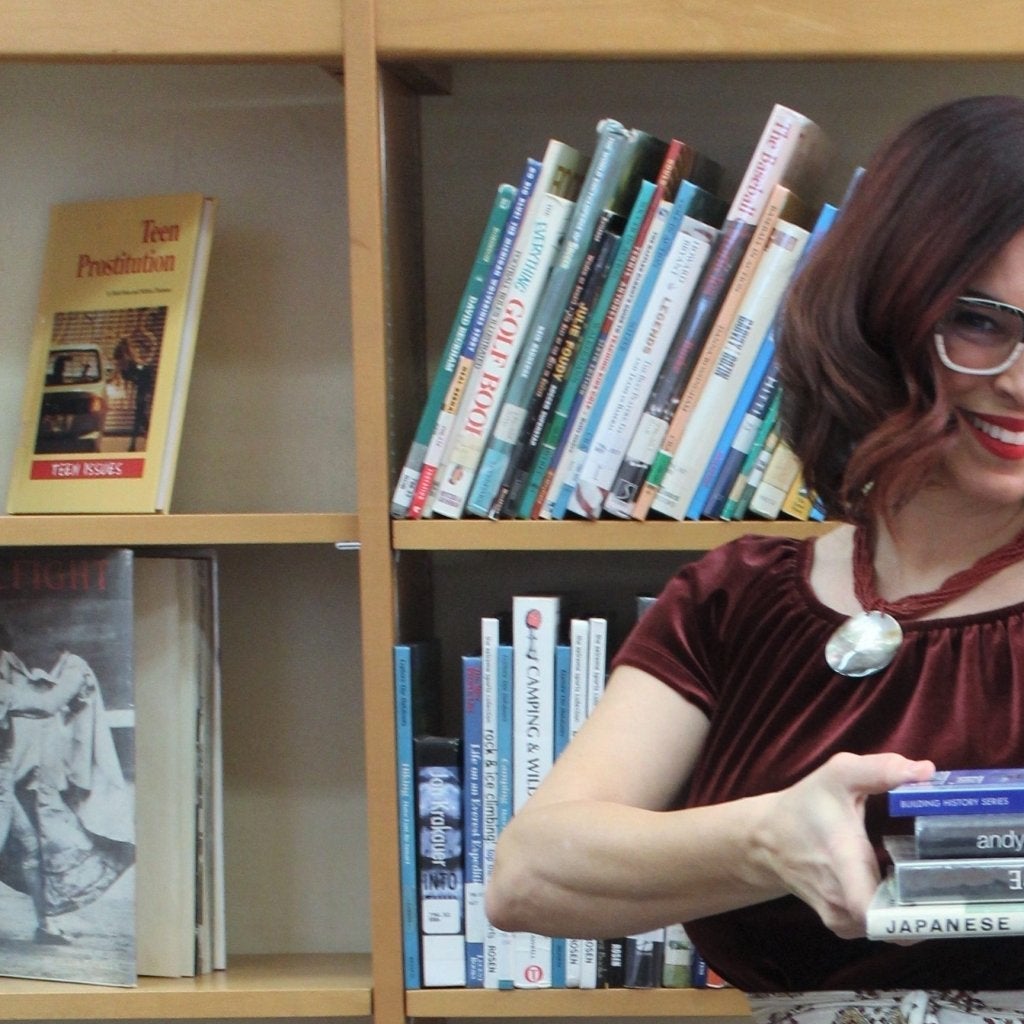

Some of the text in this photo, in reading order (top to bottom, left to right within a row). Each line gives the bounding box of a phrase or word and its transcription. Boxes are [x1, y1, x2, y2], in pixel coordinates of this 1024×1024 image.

[737, 118, 790, 216] The Baseball
[142, 219, 179, 243] Teen
[754, 204, 777, 245] BASEBALL
[76, 252, 176, 278] Prostitution
[501, 248, 521, 289] FOOTBALL
[512, 219, 552, 294] EVERYTHING
[670, 238, 691, 277] BRYANT
[677, 239, 700, 284] HOWARD
[734, 256, 755, 293] ACTION
[445, 295, 477, 372] DAVID BECKHAM
[487, 295, 528, 369] GOLF
[568, 301, 589, 337] JULIE
[641, 295, 672, 356] LEGENDS
[551, 337, 576, 382] FOUDY
[526, 666, 540, 737] CAMPING
[470, 743, 480, 762] Life
[484, 729, 496, 754] rock
[526, 743, 539, 753] &
[470, 765, 477, 779] on
[485, 758, 496, 767] &
[485, 771, 496, 789] ice
[470, 782, 478, 795] an
[900, 797, 1009, 808] BUILDING HISTORY SERIES
[428, 770, 451, 866] Jon Krakauer
[470, 798, 480, 836] Everest
[468, 840, 481, 883] Expediti
[424, 872, 457, 890] INTO
[886, 917, 1010, 934] JAPANESE
[487, 944, 498, 973] ROSEN
[584, 939, 593, 963] OSEN
[611, 943, 621, 966] ROSEN
